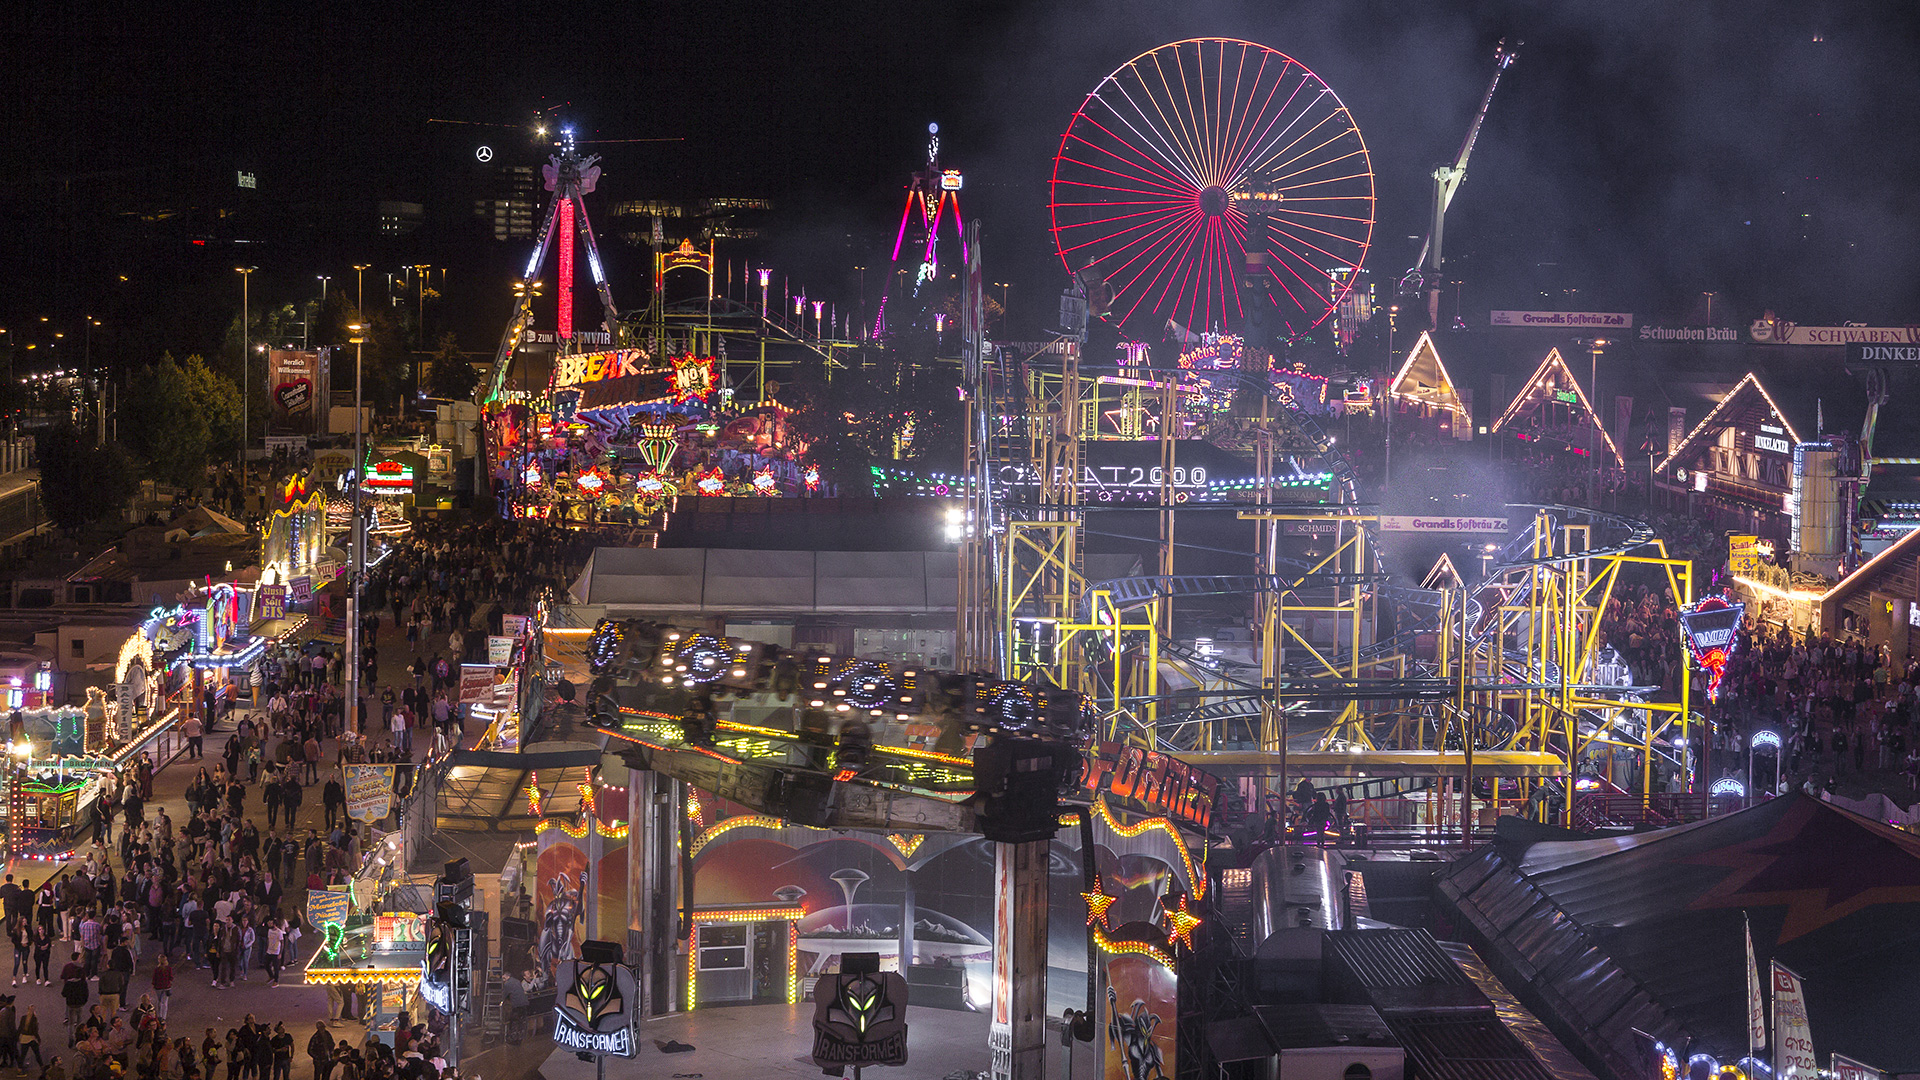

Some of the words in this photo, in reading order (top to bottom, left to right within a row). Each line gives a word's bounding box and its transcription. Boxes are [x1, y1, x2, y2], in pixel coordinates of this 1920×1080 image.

[1523, 314, 1565, 324] Grandls
[1567, 314, 1602, 326] Hofbräu
[1604, 316, 1625, 325] Zelt
[538, 334, 553, 342] ZUM
[1639, 325, 1704, 341] Schwaben
[1706, 327, 1738, 341] Bräu
[1809, 329, 1902, 343] SCHWABEN
[278, 366, 310, 374] Willkommen
[558, 351, 641, 387] BREAK
[320, 457, 350, 465] PIZZA
[376, 461, 402, 473] PIZZA
[1413, 519, 1456, 529] Grandls
[1457, 519, 1492, 530] Hofbräu
[263, 587, 285, 596] Slush
[150, 603, 185, 621] Slush
[262, 606, 284, 619] EIS
[309, 900, 348, 911] Mandeln
[554, 1007, 630, 1056] TRANSFORMER
[814, 1021, 905, 1064] TRANSFORMER
